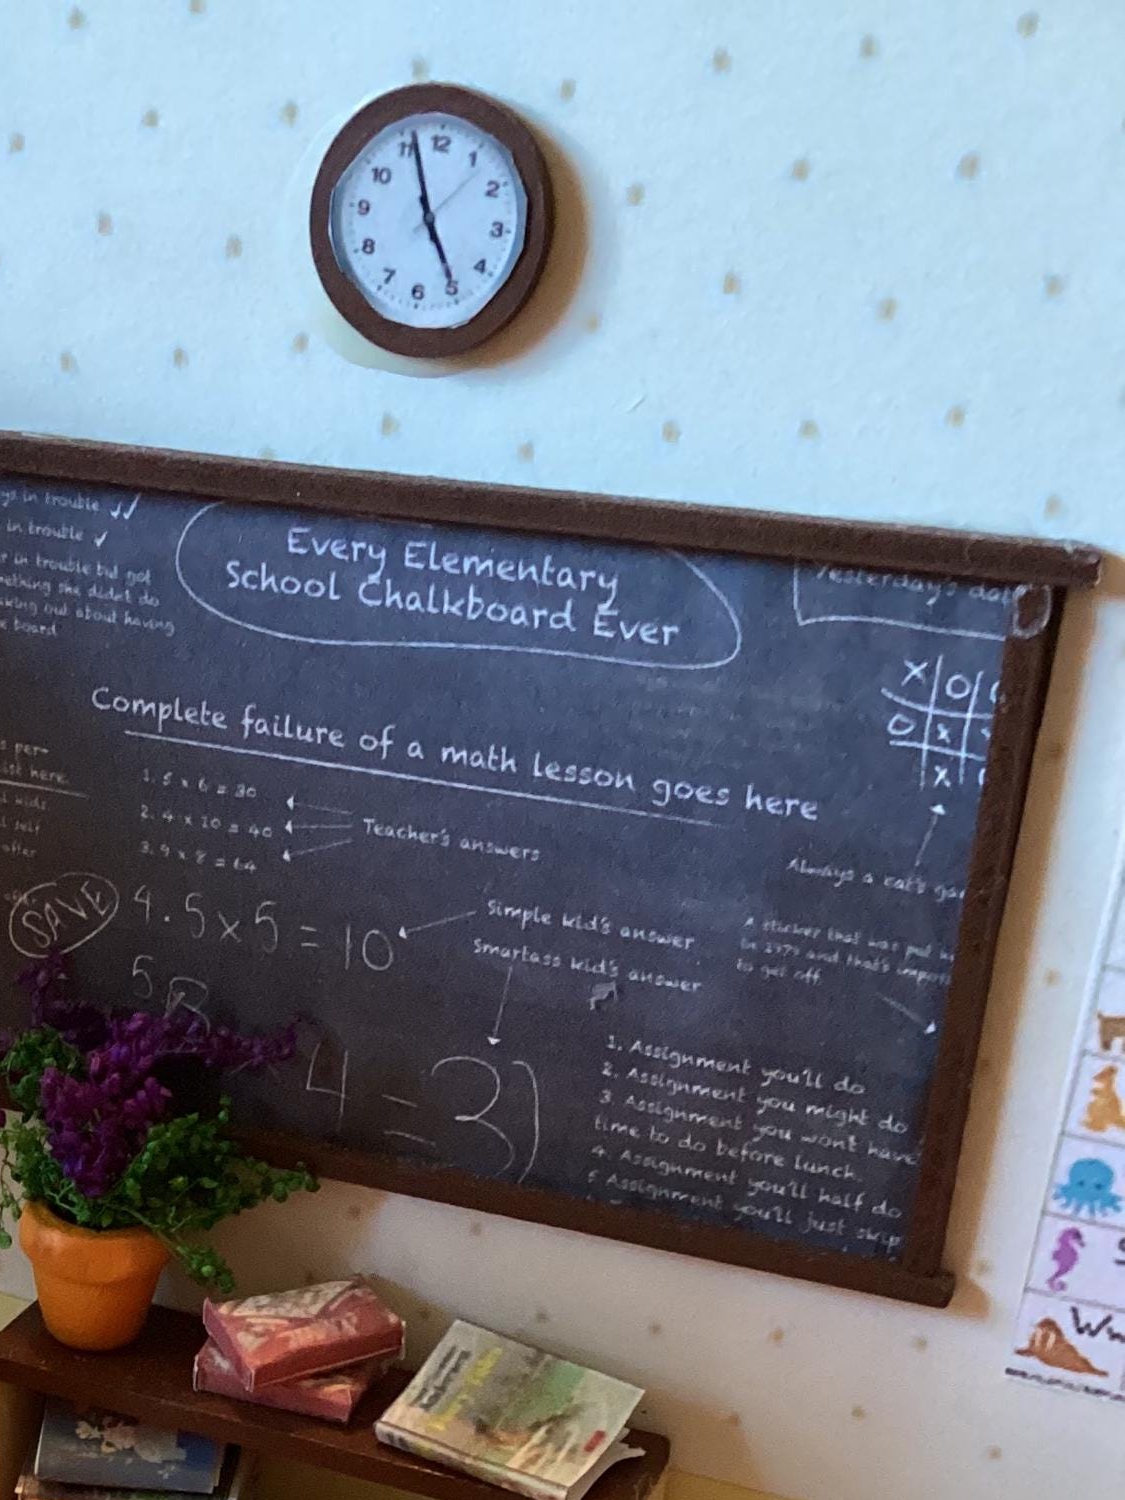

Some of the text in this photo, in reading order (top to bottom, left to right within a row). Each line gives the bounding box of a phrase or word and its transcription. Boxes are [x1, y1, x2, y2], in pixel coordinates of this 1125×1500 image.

[431, 135, 452, 153] 12
[468, 151, 478, 167] 1
[371, 166, 392, 185] 10
[485, 180, 501, 198] 2
[357, 200, 371, 215] 9
[489, 222, 505, 238] 3
[362, 238, 376, 254] 8
[382, 268, 396, 285] 7
[474, 258, 487, 274] 4
[411, 284, 425, 300] 6
[445, 280, 459, 296] 5
[22, 490, 38, 503] in
[45, 492, 100, 513] trouble
[7, 519, 24, 534] in
[28, 521, 84, 542] trouble
[14, 552, 29, 566] in
[36, 553, 90, 576] trouble
[287, 526, 620, 609] Every Elementary
[138, 588, 160, 608] do
[225, 560, 682, 648] School Chalkboard Ever
[14, 616, 59, 638] board
[75, 602, 117, 624] about
[123, 610, 175, 638] having
[90, 686, 820, 823] Complete failure of a math lesson goes here
[162, 771, 174, 787] 5
[197, 775, 209, 793] 6
[248, 823, 274, 840] 40
[362, 816, 541, 862] Teacher's answers
[785, 857, 855, 888] Always
[861, 872, 874, 885] a
[21, 880, 112, 949] SAVE
[487, 898, 554, 932] Simple
[618, 924, 696, 951] answer
[185, 891, 207, 940] 5
[254, 900, 280, 953] 5
[344, 923, 395, 972] 10
[474, 937, 562, 969] Smartass
[627, 968, 703, 994] answer
[805, 949, 839, 964] and
[628, 1038, 753, 1077] Assignment
[832, 1072, 867, 1095] do
[626, 1065, 748, 1104] Assignment
[756, 1095, 798, 1117] you
[805, 1104, 871, 1130] might
[877, 1113, 909, 1134] do
[624, 1094, 744, 1132] Assignment
[752, 1123, 792, 1143] you
[594, 1114, 641, 1139] time
[649, 1125, 675, 1145] to
[677, 1131, 707, 1152] do
[716, 1137, 786, 1168] before
[619, 1148, 738, 1186] Assignment
[818, 1187, 865, 1213] half
[871, 1198, 903, 1219] do
[605, 1172, 724, 1211] Assignment
[801, 1210, 847, 1236] just
